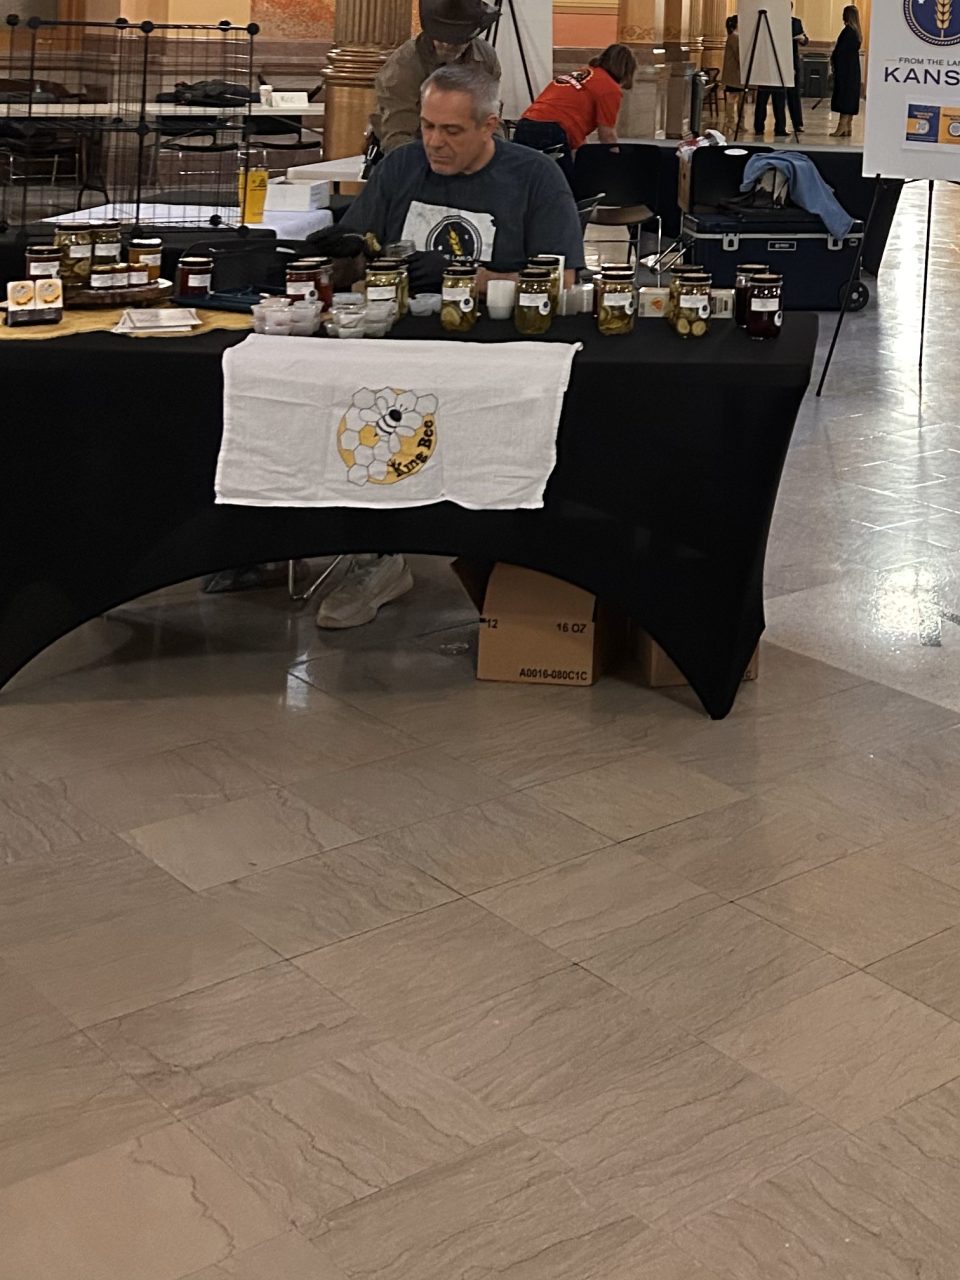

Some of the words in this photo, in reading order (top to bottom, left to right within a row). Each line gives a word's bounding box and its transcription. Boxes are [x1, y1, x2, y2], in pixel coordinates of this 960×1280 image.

[898, 57, 924, 65] FROM
[926, 58, 944, 66] THE
[389, 451, 428, 477] King
[417, 420, 433, 450] Bee
[556, 623, 569, 634] 16
